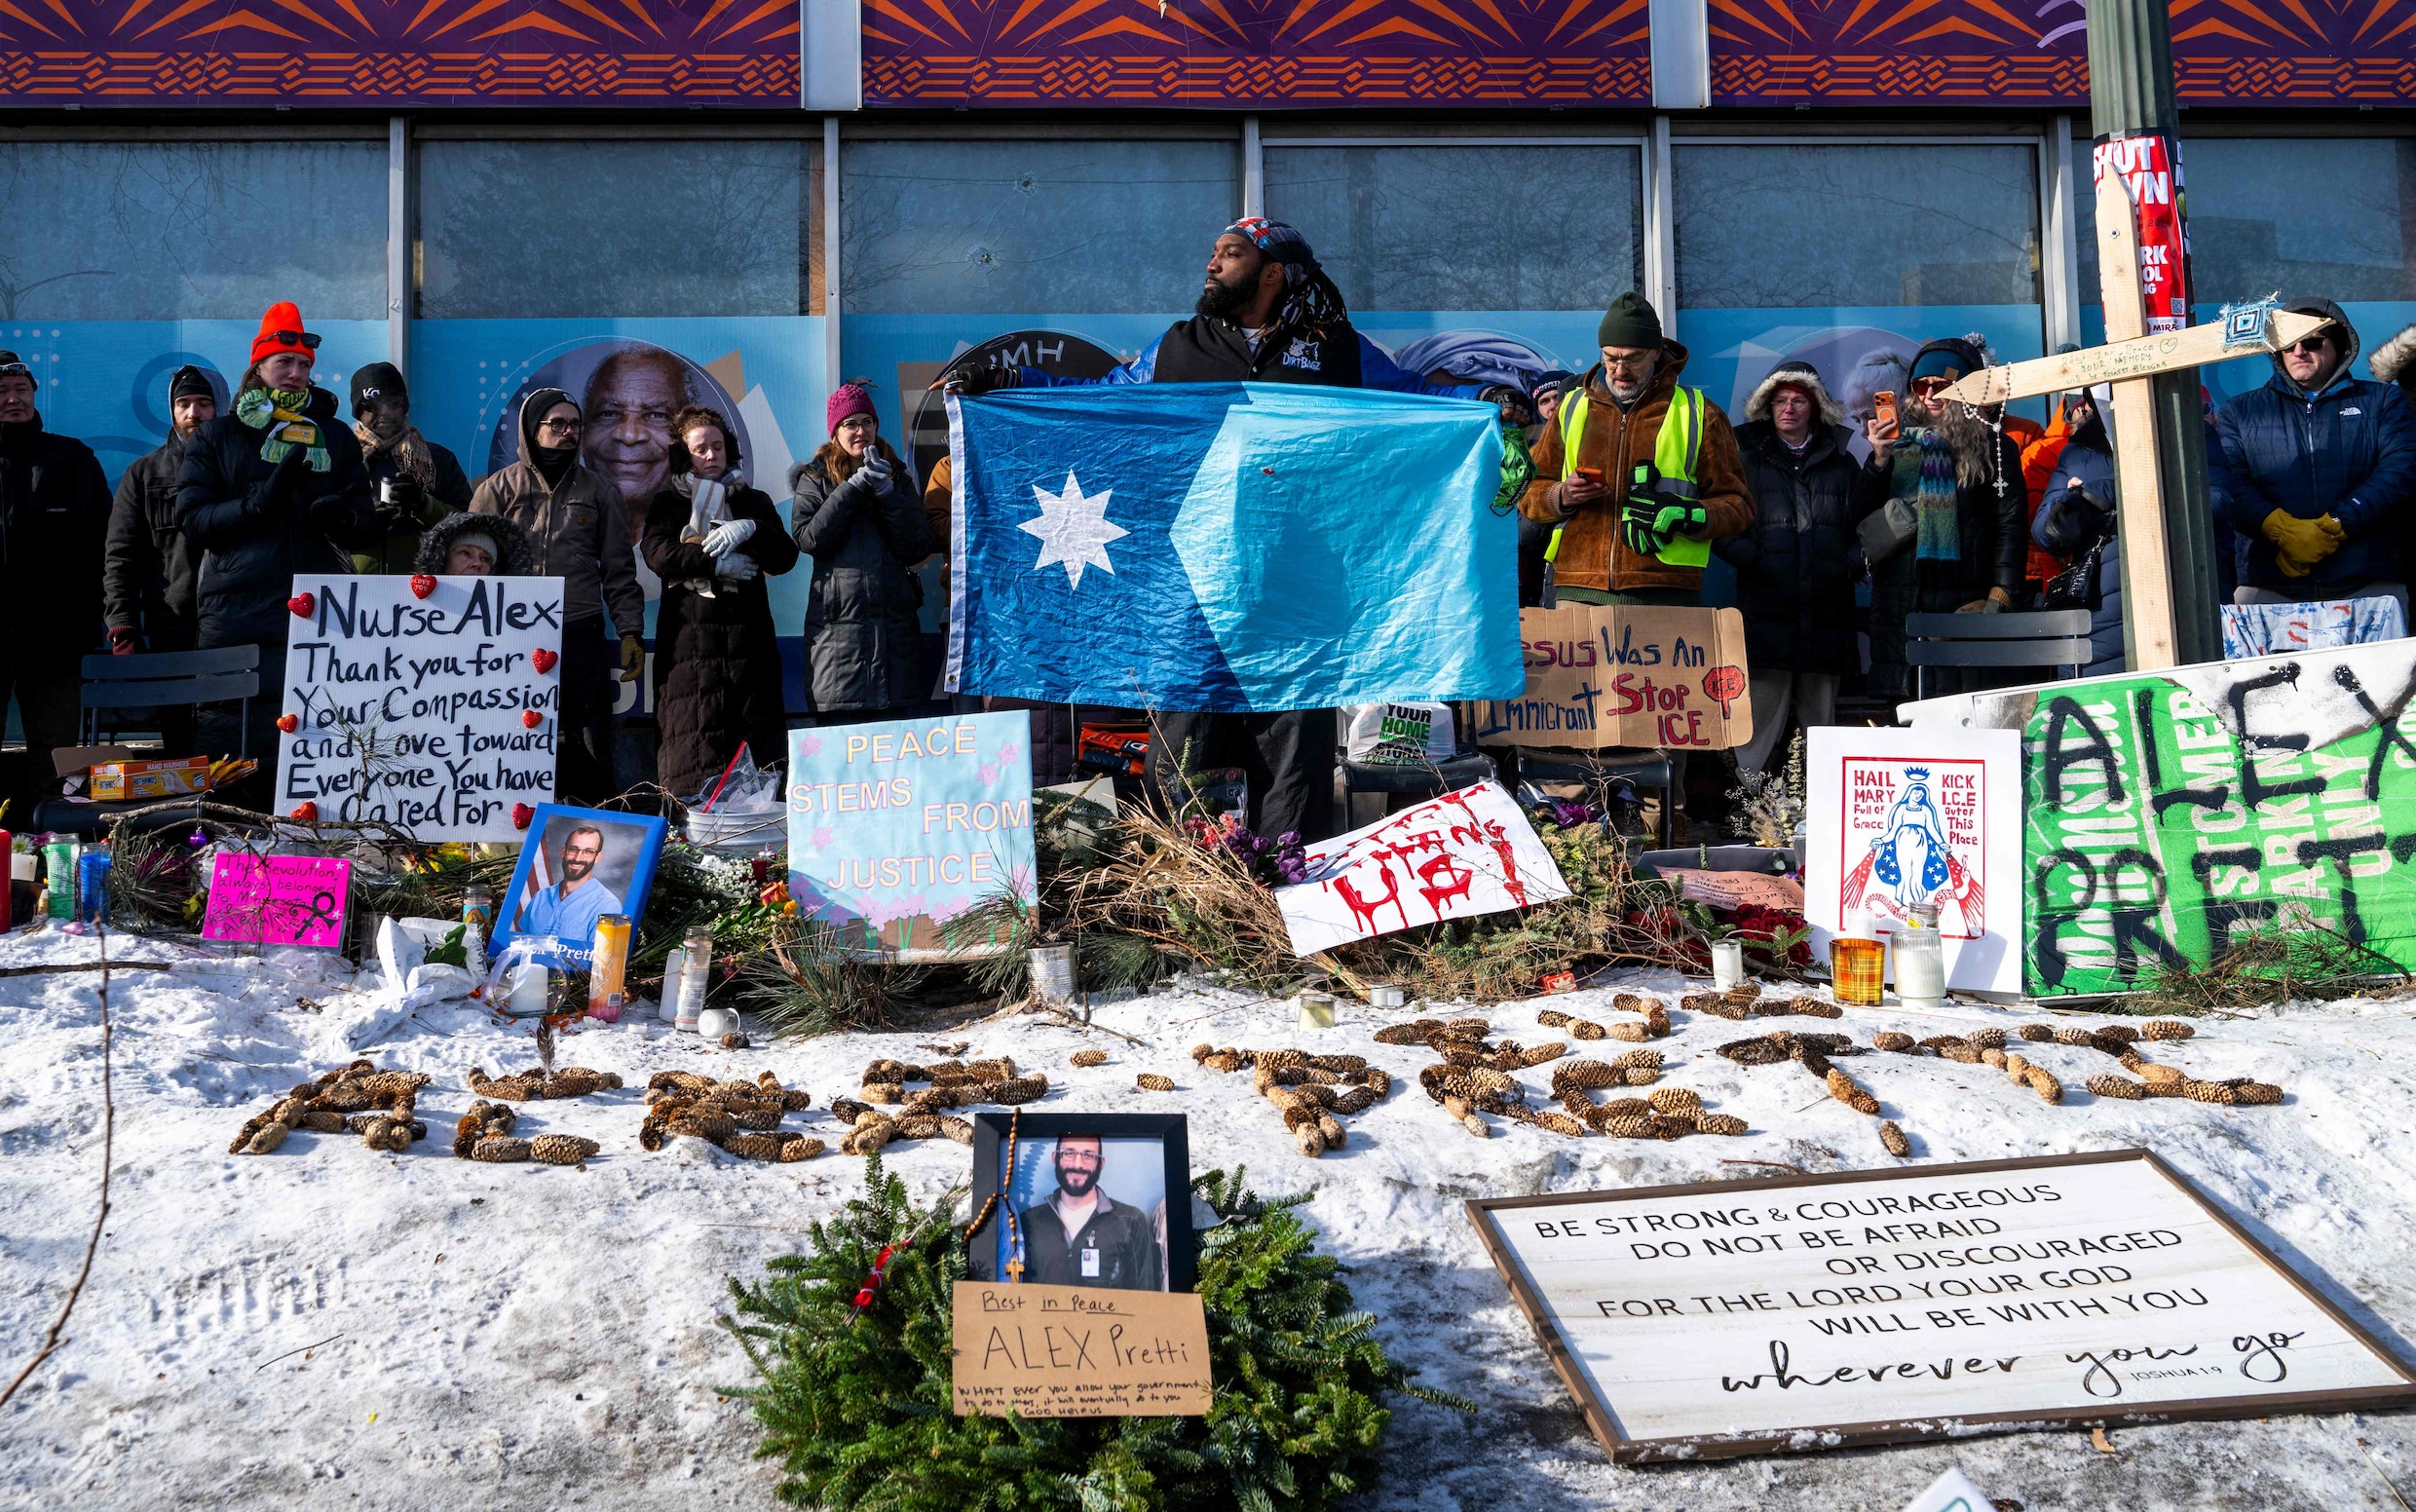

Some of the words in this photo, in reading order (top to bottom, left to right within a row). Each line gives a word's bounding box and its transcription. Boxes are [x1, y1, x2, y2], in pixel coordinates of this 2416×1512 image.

[318, 582, 453, 638] Nurse
[1520, 640, 1597, 667] esus
[1601, 624, 1661, 667] Was
[1673, 636, 1705, 669] An
[293, 643, 402, 683] Thank
[409, 655, 465, 689] you
[466, 644, 524, 676] for
[293, 685, 376, 731] Your
[383, 684, 558, 723] Compassion
[1387, 702, 1432, 723] YOUR
[1478, 682, 1603, 738] Immigrant
[1606, 672, 1690, 717] Stop
[292, 729, 354, 759] and
[456, 719, 554, 762] toward
[847, 725, 976, 764] PEACE
[1380, 716, 1431, 740] HOME
[1657, 710, 1711, 746] ICE
[286, 762, 435, 799] Everyone
[444, 758, 494, 791] You
[495, 758, 553, 790] have
[1854, 770, 1896, 787] HAIL
[1854, 789, 1896, 803] MARY
[1942, 774, 1975, 789] KICK
[341, 786, 446, 827] Cared
[453, 790, 503, 827] For
[790, 777, 912, 813] STEMS
[923, 799, 1030, 834] FROM
[1854, 804, 1871, 814] Full
[1854, 816, 1884, 829] Grace
[1946, 816, 1974, 830] This
[1949, 831, 1978, 846] Place
[218, 879, 266, 893] always
[278, 879, 336, 895] belonged
[826, 852, 994, 890] JUSTICE
[216, 891, 228, 903] to
[552, 944, 594, 962] Prett
[1534, 1219, 1587, 1239] BE
[1595, 1207, 1759, 1235] STRONG
[1767, 1206, 1791, 1223] &
[1796, 1185, 2062, 1222] COURAGEOUS
[1629, 1240, 1691, 1261] DO
[1703, 1232, 1784, 1257] NOT
[1801, 1228, 1854, 1250] BE
[1866, 1217, 2001, 1246] AFRAID
[1826, 1255, 1887, 1275] OR
[1894, 1229, 2182, 1271] DISCOURAGED
[982, 1291, 1026, 1310] Rest
[1041, 1295, 1058, 1308] in
[1072, 1294, 1116, 1312] Peace
[1596, 1298, 1685, 1318] FOR
[1690, 1293, 1781, 1313] THE
[1787, 1283, 1903, 1308] LORD
[1907, 1272, 2035, 1300] YOUR
[2040, 1265, 2133, 1289] GOD
[1808, 1313, 1920, 1337] WILL
[1925, 1307, 1985, 1329] BE
[1987, 1298, 2109, 1324] WITH
[2111, 1287, 2209, 1310] YOU
[983, 1326, 1096, 1371] ALEX
[1109, 1323, 1189, 1367] Pretti
[1721, 1340, 2021, 1392] wherever
[2065, 1343, 2199, 1398] you
[2232, 1330, 2307, 1383] go
[958, 1385, 1004, 1397] WHAT
[1076, 1383, 1103, 1392] allow
[1109, 1383, 1131, 1395] your
[1137, 1380, 1198, 1392] government
[2131, 1366, 2198, 1382] JOSHUA
[2199, 1366, 2223, 1377] 1:9
[963, 1398, 975, 1407] to
[1043, 1396, 1054, 1406] it
[1079, 1394, 1129, 1408] eventually
[1163, 1394, 1181, 1404] you
